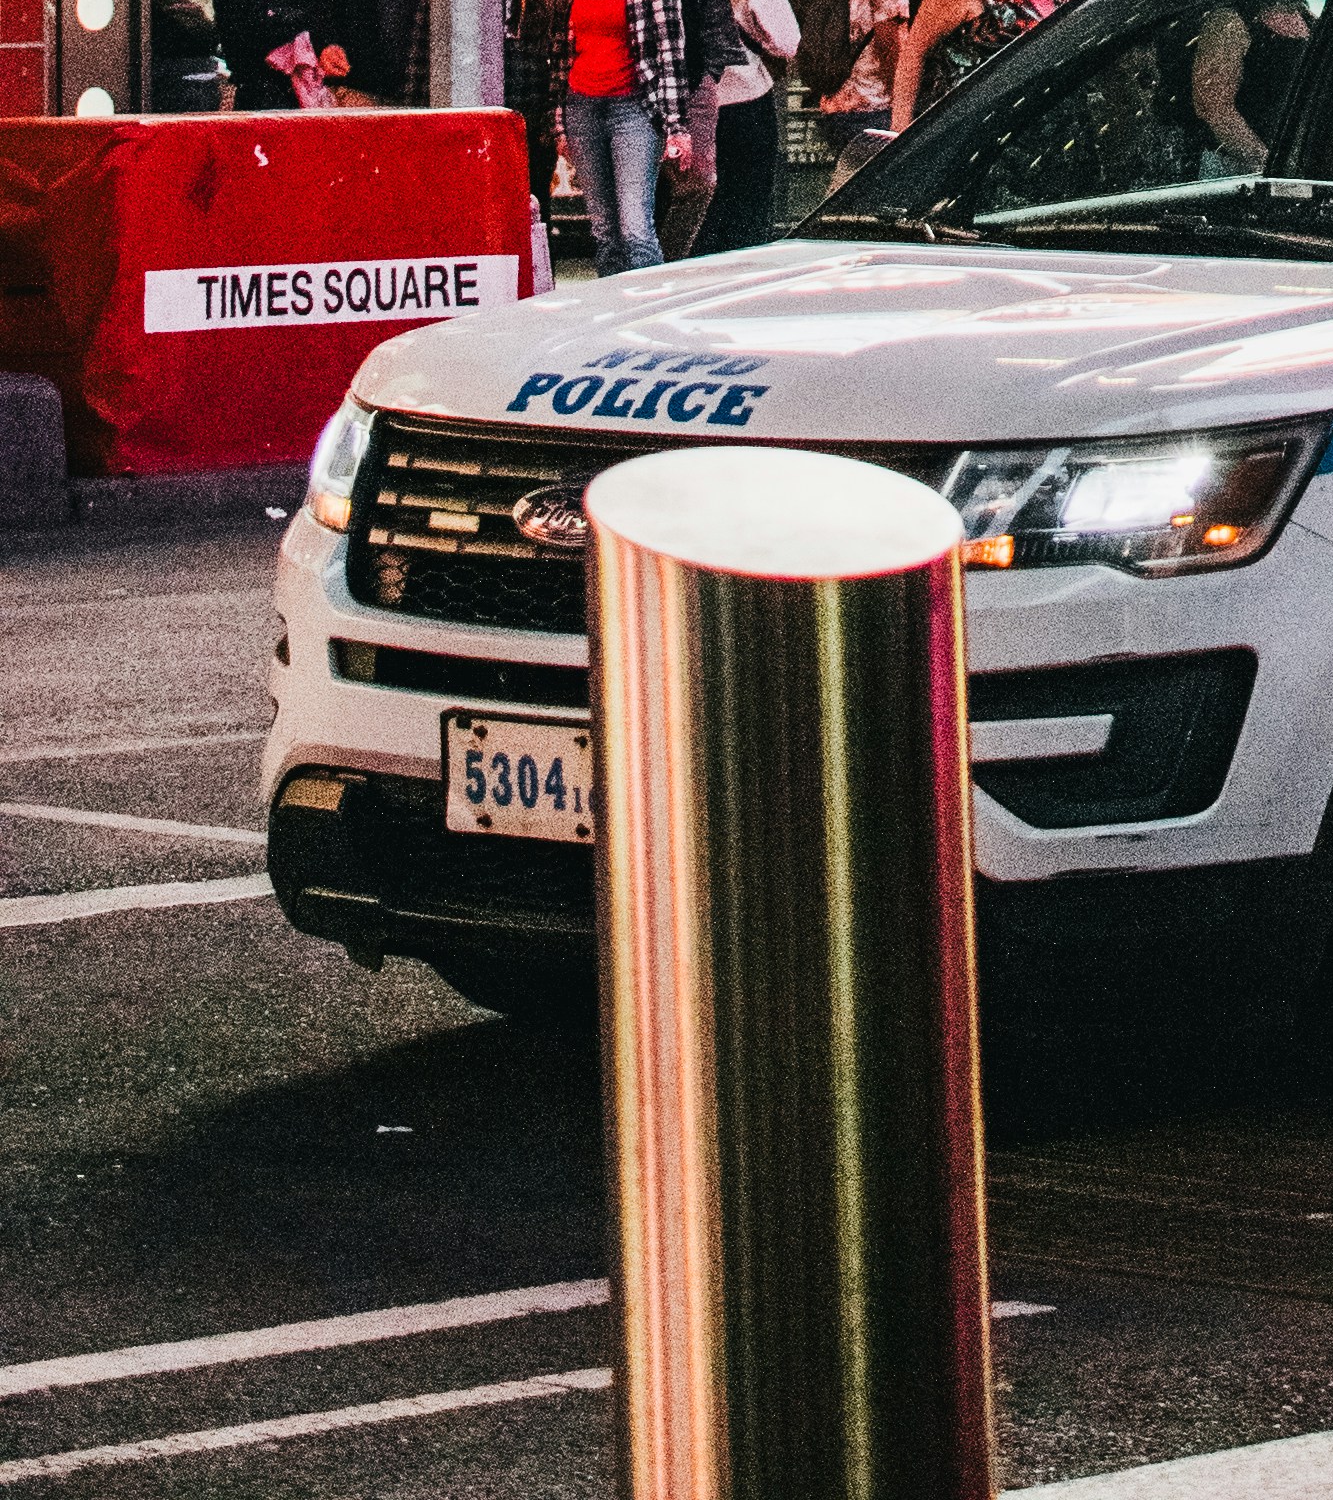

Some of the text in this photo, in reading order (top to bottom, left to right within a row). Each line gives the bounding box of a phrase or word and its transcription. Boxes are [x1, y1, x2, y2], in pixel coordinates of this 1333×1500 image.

[196, 262, 480, 320] TIMES SQUARE
[582, 349, 771, 377] NYPD
[506, 371, 772, 427] POLICE
[466, 749, 568, 812] 5304
